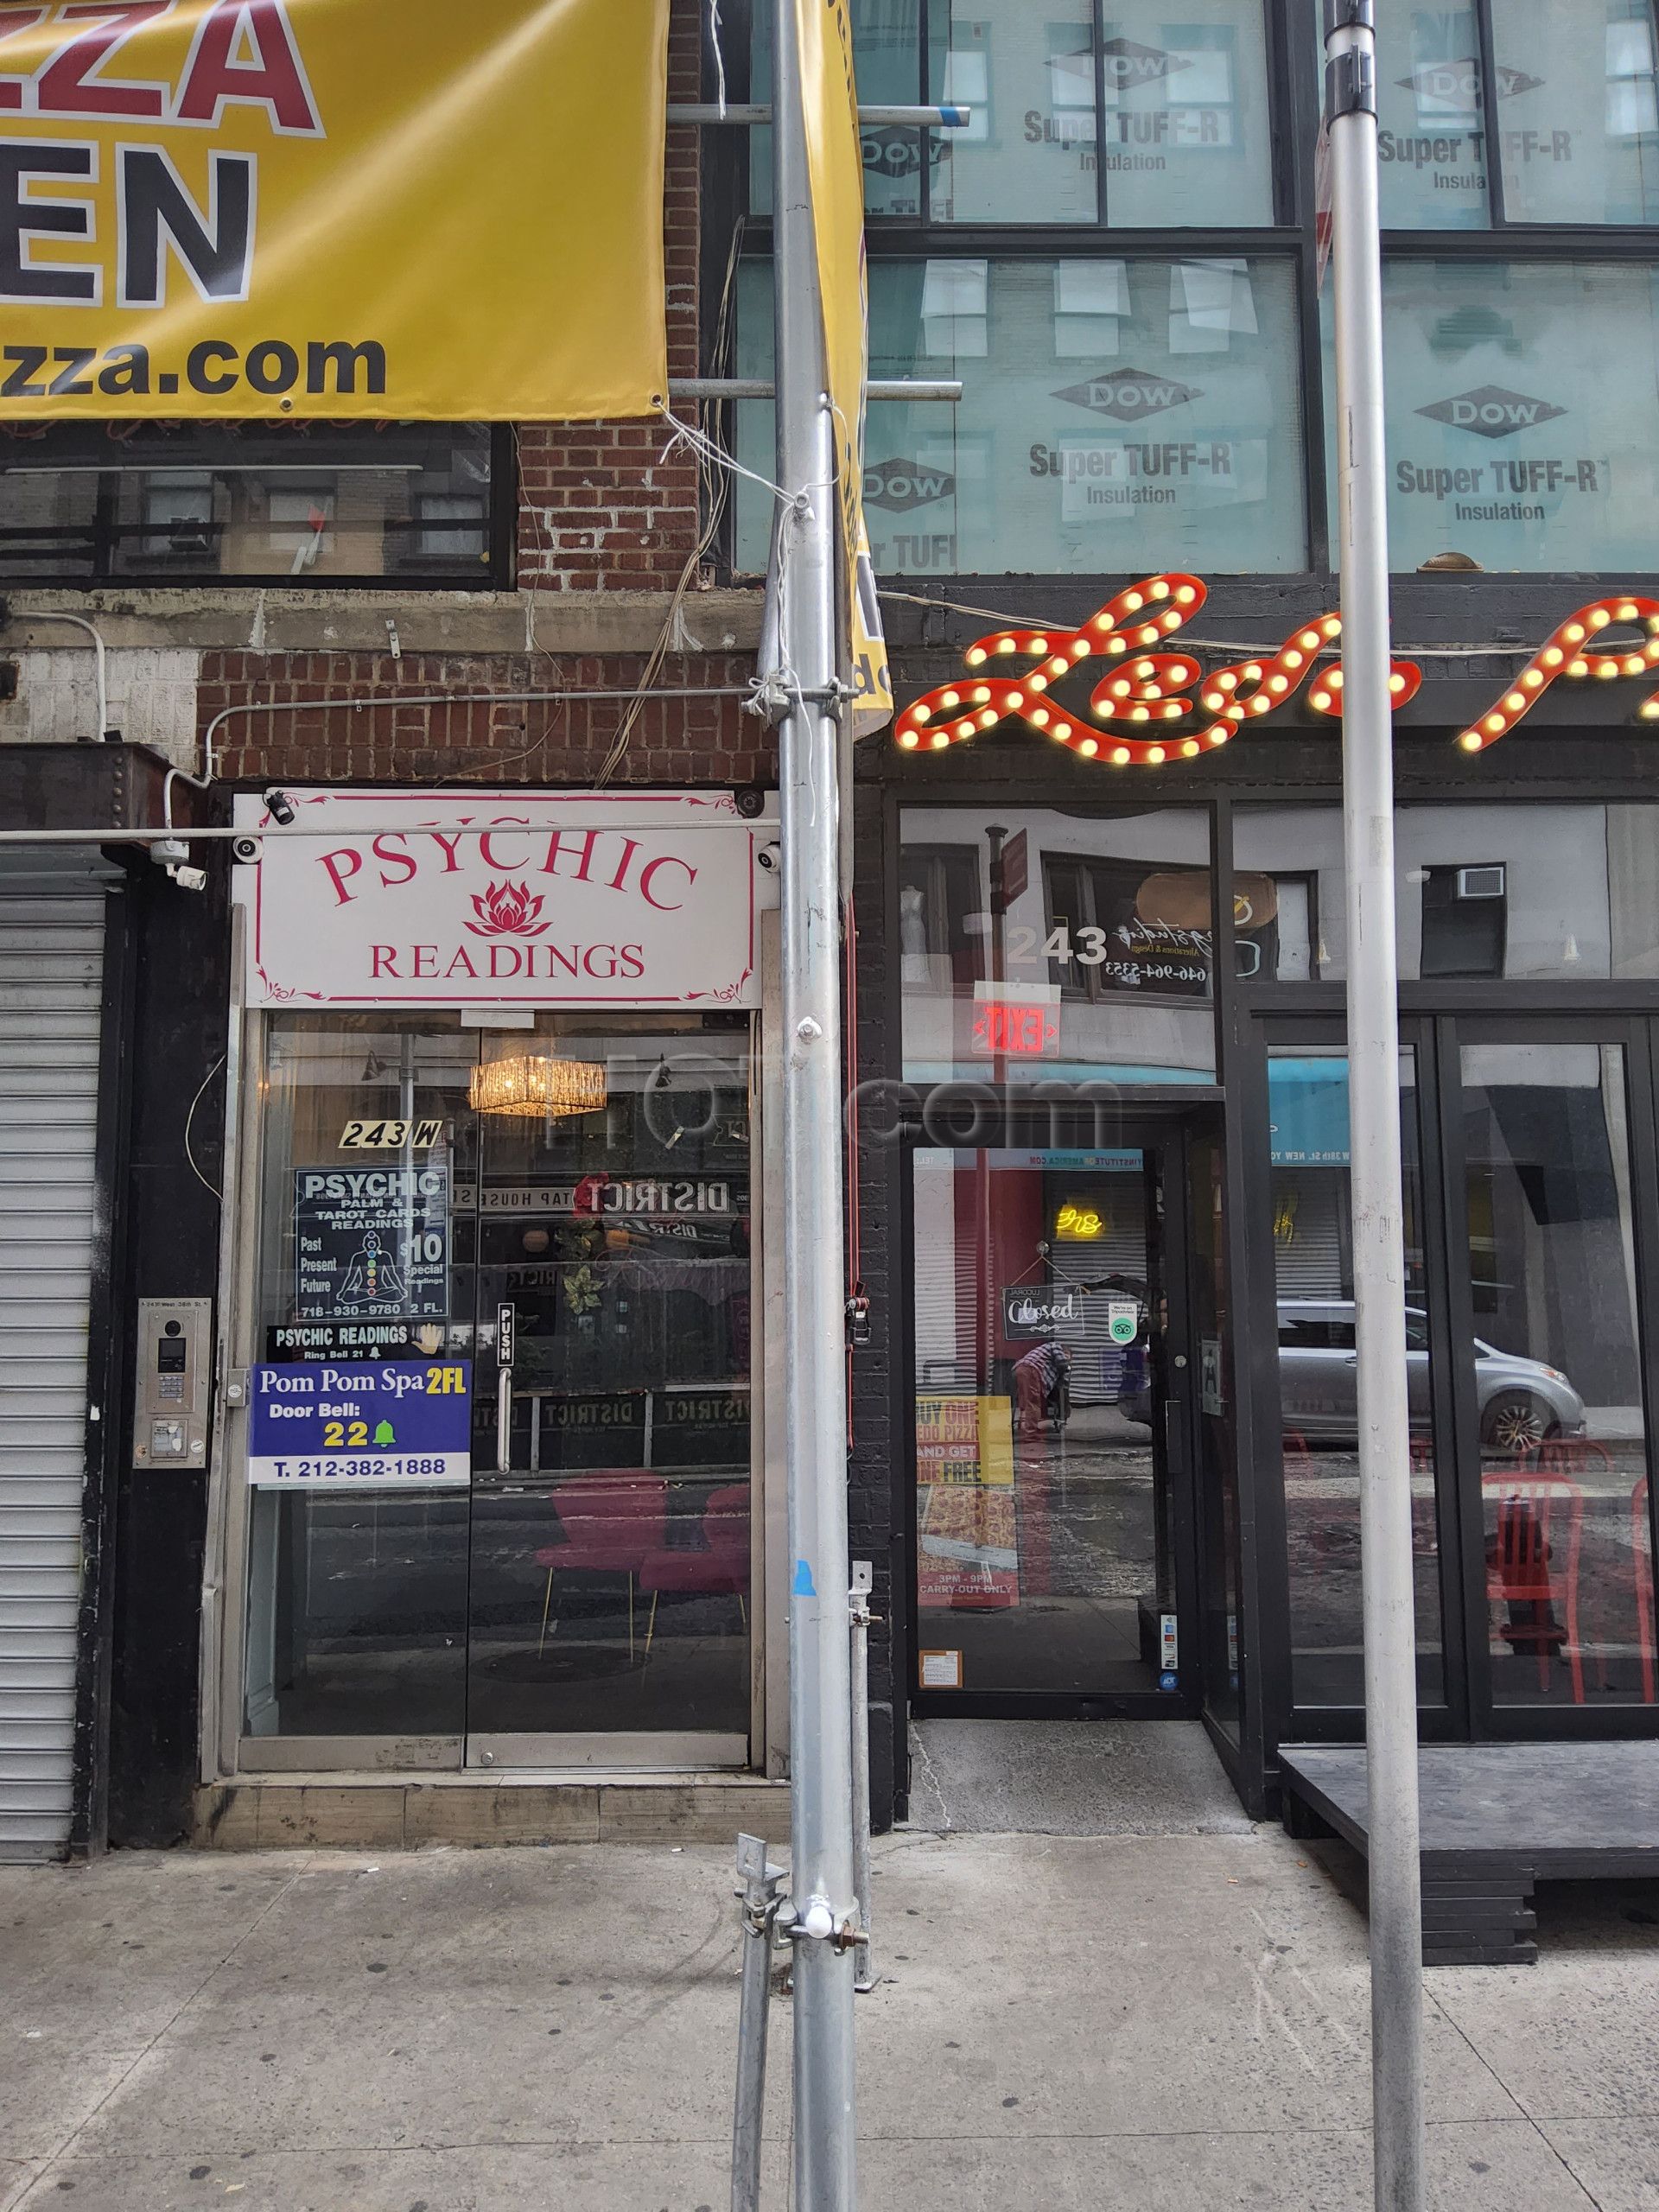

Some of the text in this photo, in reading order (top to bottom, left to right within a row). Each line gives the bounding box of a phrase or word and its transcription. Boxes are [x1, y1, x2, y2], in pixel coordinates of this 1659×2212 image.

[1024, 110, 1108, 150] Supe
[1377, 130, 1573, 169] Super TFF-R
[1080, 152, 1166, 171] Inulation
[1087, 384, 1179, 407] DOW
[1450, 399, 1541, 425] DOW
[1029, 443, 1117, 485] Super
[1396, 460, 1484, 501] Super
[1086, 486, 1176, 505] Insulation
[1455, 502, 1546, 520] Insulation
[315, 817, 698, 912] PSYCHIC
[1007, 925, 1108, 965] 243
[367, 943, 645, 979] READINGS
[343, 1122, 440, 1147] 243 W
[305, 1171, 442, 1198] PSYCHIC
[315, 1207, 431, 1221] TAROT CARDS
[340, 1198, 404, 1209] PALM &
[331, 1218, 414, 1230] READINGS
[300, 1236, 322, 1252] Past
[399, 1233, 443, 1263] $10
[300, 1257, 337, 1273] Present
[403, 1264, 443, 1276] Special
[300, 1278, 332, 1293] Future
[302, 1303, 401, 1318] 718-930-9780
[410, 1304, 419, 1314] 2
[1008, 1294, 1079, 1324] Closed
[276, 1325, 409, 1347] PSYCHIC READINGS
[500, 1309, 512, 1360] PUSH
[304, 1350, 364, 1361] Ring Bell 21
[259, 1367, 467, 1398] Pom Pom Spa 2FL
[269, 1402, 360, 1419] Door Bell:
[323, 1421, 369, 1447] 22
[916, 1445, 976, 1459] AND GET
[274, 1459, 446, 1478] T. 212-382-1888
[943, 1460, 981, 1483] FREE
[919, 1585, 1012, 1594] CARRY-OUT ONLY
[939, 1574, 961, 1583] 3PM
